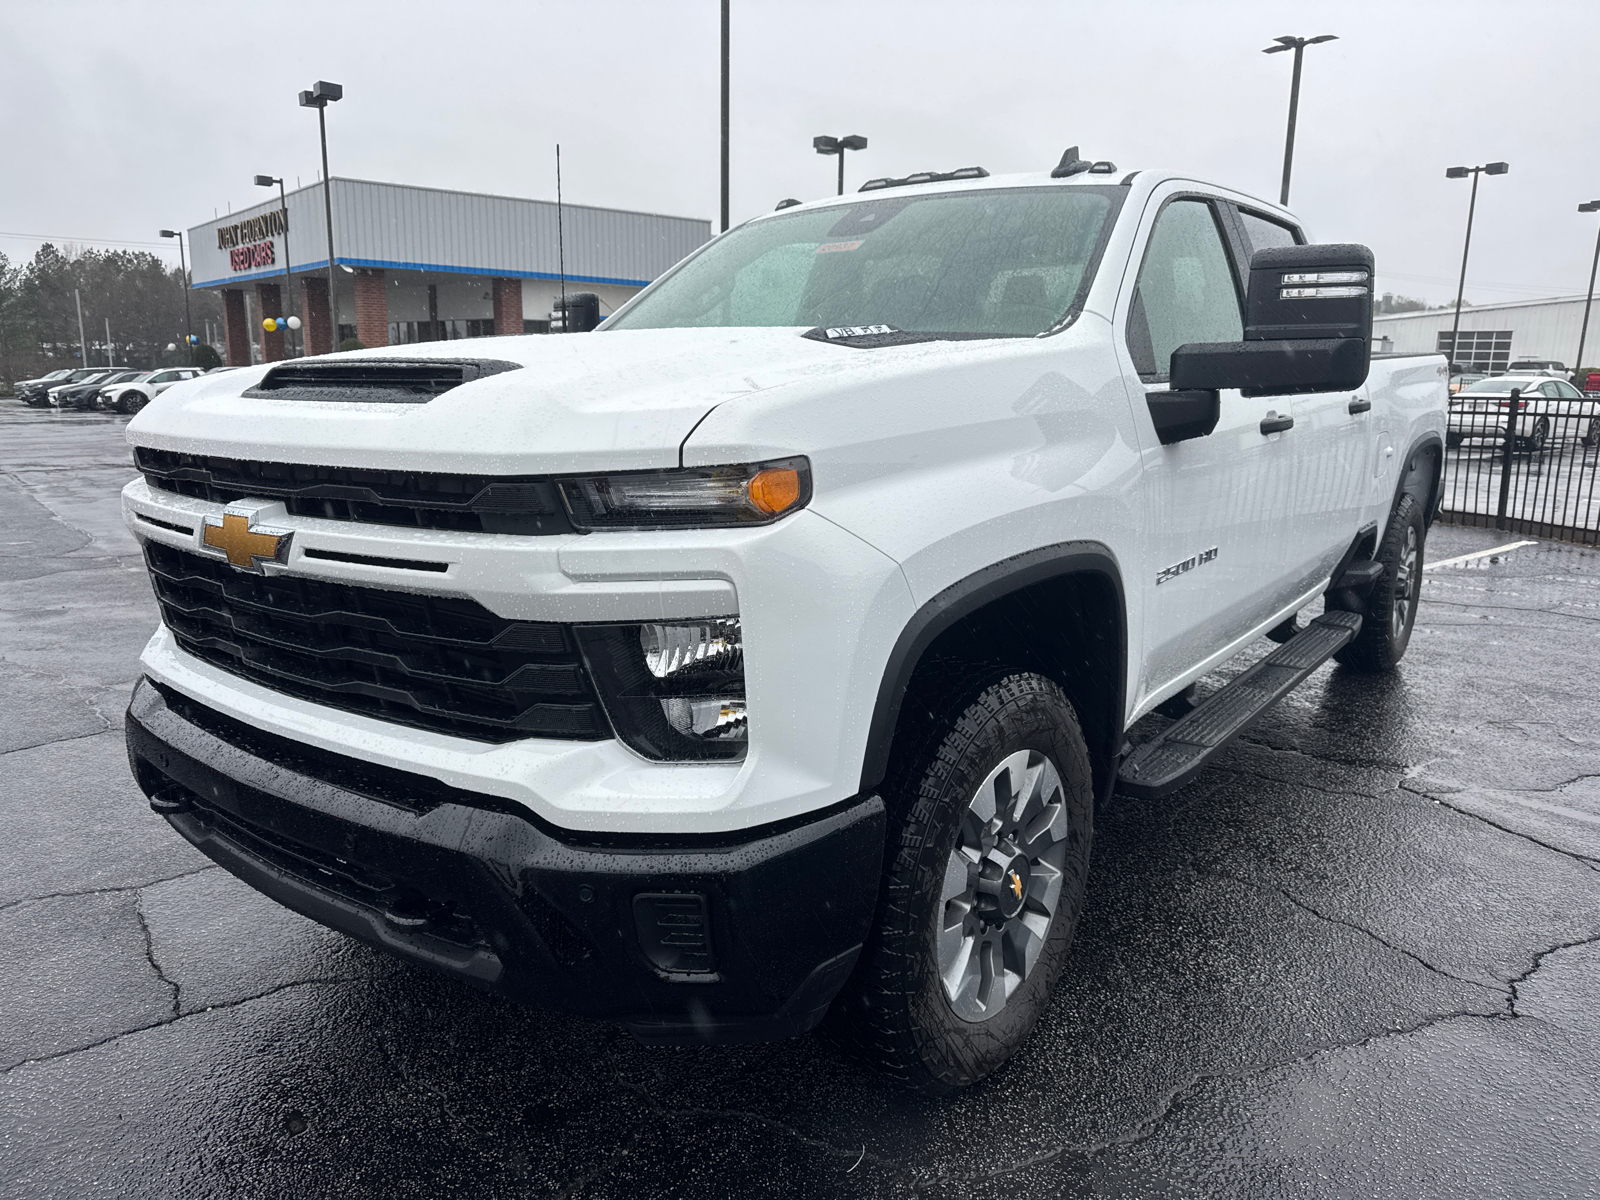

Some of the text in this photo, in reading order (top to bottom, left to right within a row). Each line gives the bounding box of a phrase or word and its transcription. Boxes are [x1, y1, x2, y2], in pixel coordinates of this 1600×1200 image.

[217, 207, 289, 250] JOHN THORNTON
[229, 240, 275, 272] USED CARS
[1155, 545, 1219, 586] 2500 HD
